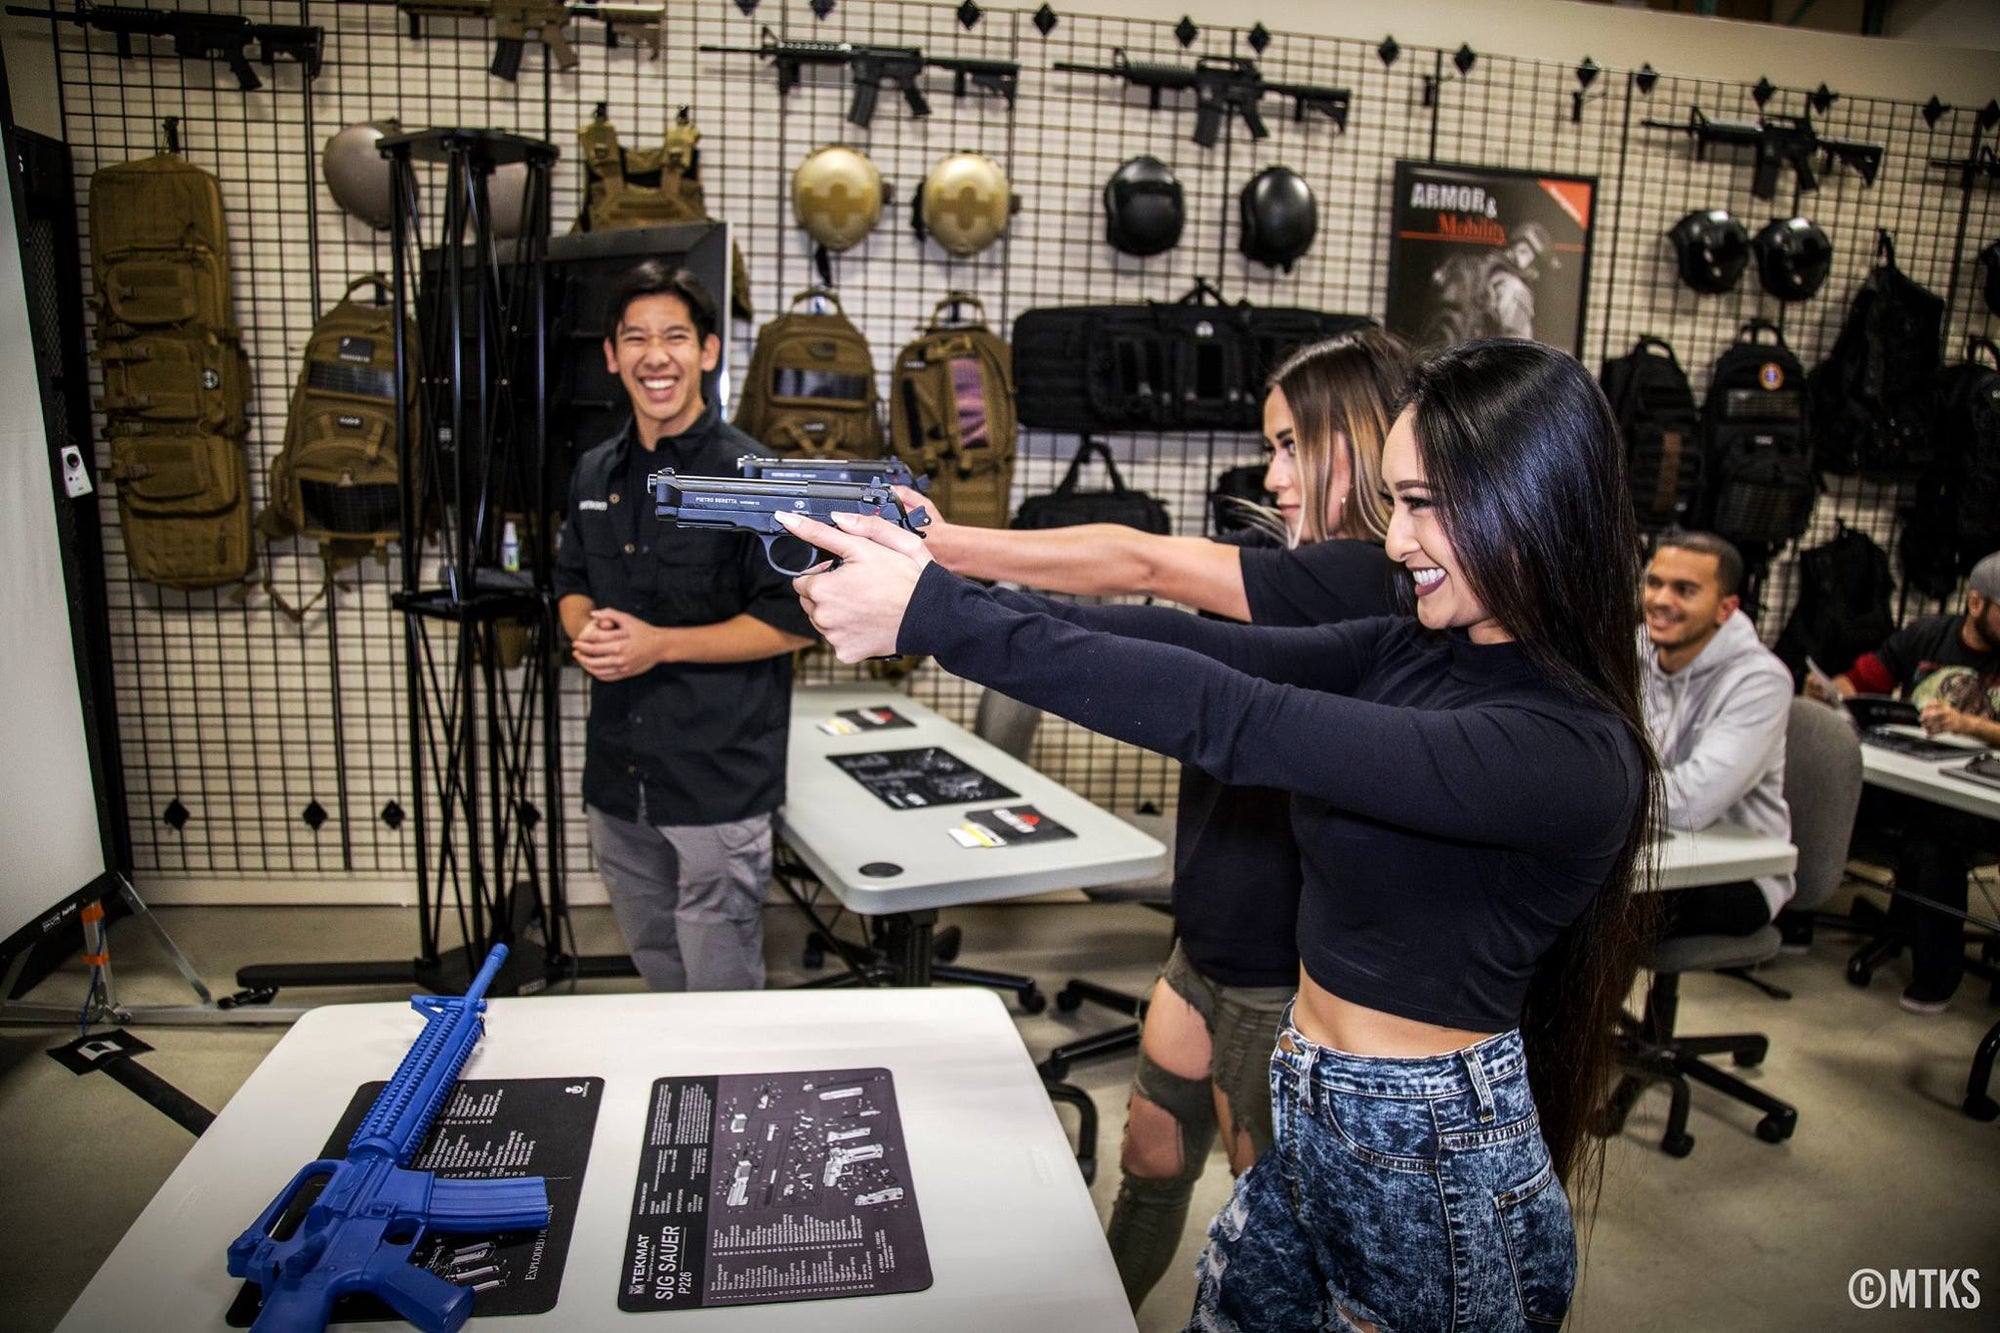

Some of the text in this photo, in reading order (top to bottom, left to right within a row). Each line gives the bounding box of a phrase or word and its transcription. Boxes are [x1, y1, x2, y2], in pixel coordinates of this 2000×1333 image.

[1411, 182, 1485, 213] ARMOR
[524, 1238, 546, 1281] EXPLODED
[632, 1234, 650, 1284] TEKMAT
[658, 1225, 680, 1272] SAUER
[655, 1275, 675, 1300] SIG
[678, 1271, 692, 1295] P226
